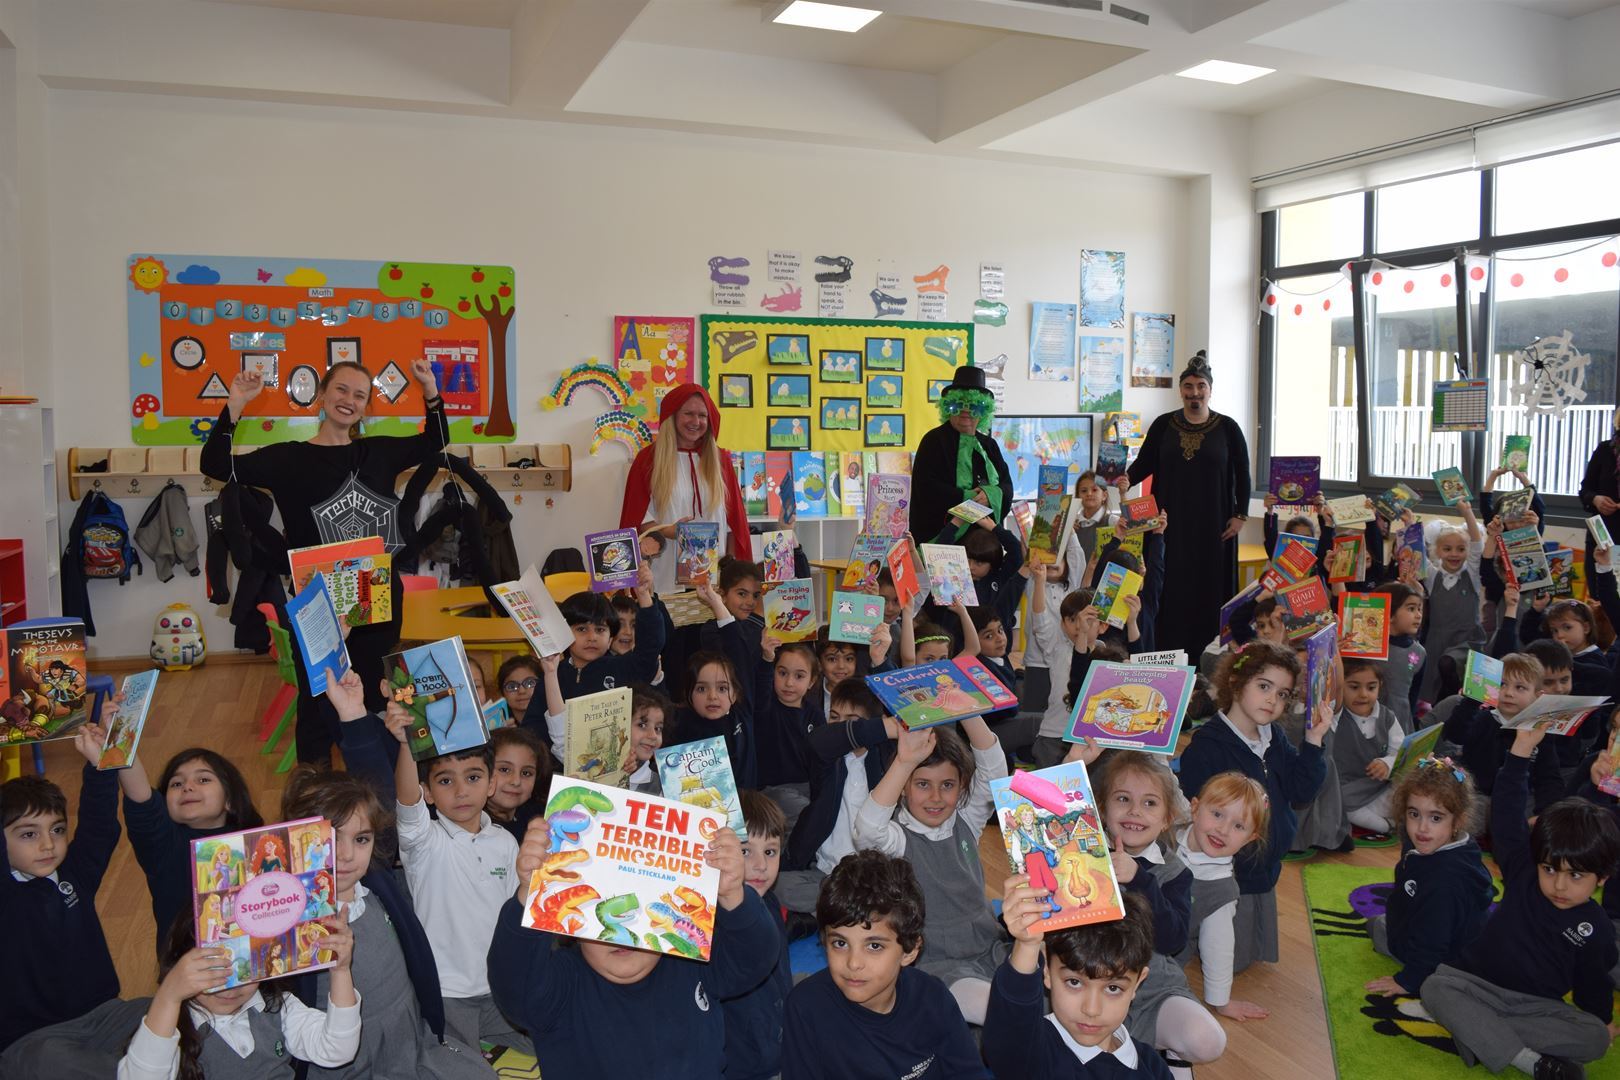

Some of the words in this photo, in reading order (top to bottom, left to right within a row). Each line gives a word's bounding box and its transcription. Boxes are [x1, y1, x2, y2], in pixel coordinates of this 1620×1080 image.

[312, 288, 331, 296] Math
[170, 304, 179, 317] 0
[224, 303, 233, 316] 2
[251, 306, 259, 319] 3
[279, 311, 286, 324] 4
[306, 304, 313, 316] 5
[330, 309, 338, 321] 6
[356, 302, 364, 314] 7
[381, 305, 389, 318] 8
[407, 301, 414, 315] 9
[430, 312, 443, 325] 10
[620, 318, 642, 360] A
[643, 326, 656, 337] Aa
[621, 360, 631, 368] Cc
[655, 388, 666, 396] Kk
[878, 484, 904, 494] Princess
[333, 573, 345, 614] Fabulous
[344, 575, 356, 605] Facts
[789, 587, 810, 595] Flying
[23, 628, 73, 640] THESEVS
[11, 643, 79, 656] MINOTAVR
[883, 668, 949, 686] Cinderella
[1132, 671, 1167, 679] Sleeping
[584, 712, 603, 722] PETER
[604, 707, 624, 717] RABBIT
[665, 746, 716, 768] Captain
[688, 757, 722, 774] Cook
[626, 798, 690, 836] TEN
[600, 822, 706, 861] TERRIBLE
[596, 842, 702, 877] DINOSAURS
[618, 864, 636, 874] PAUL
[638, 869, 676, 882] STICKLAND
[241, 893, 300, 913] Storybook
[252, 908, 290, 920] Collection
